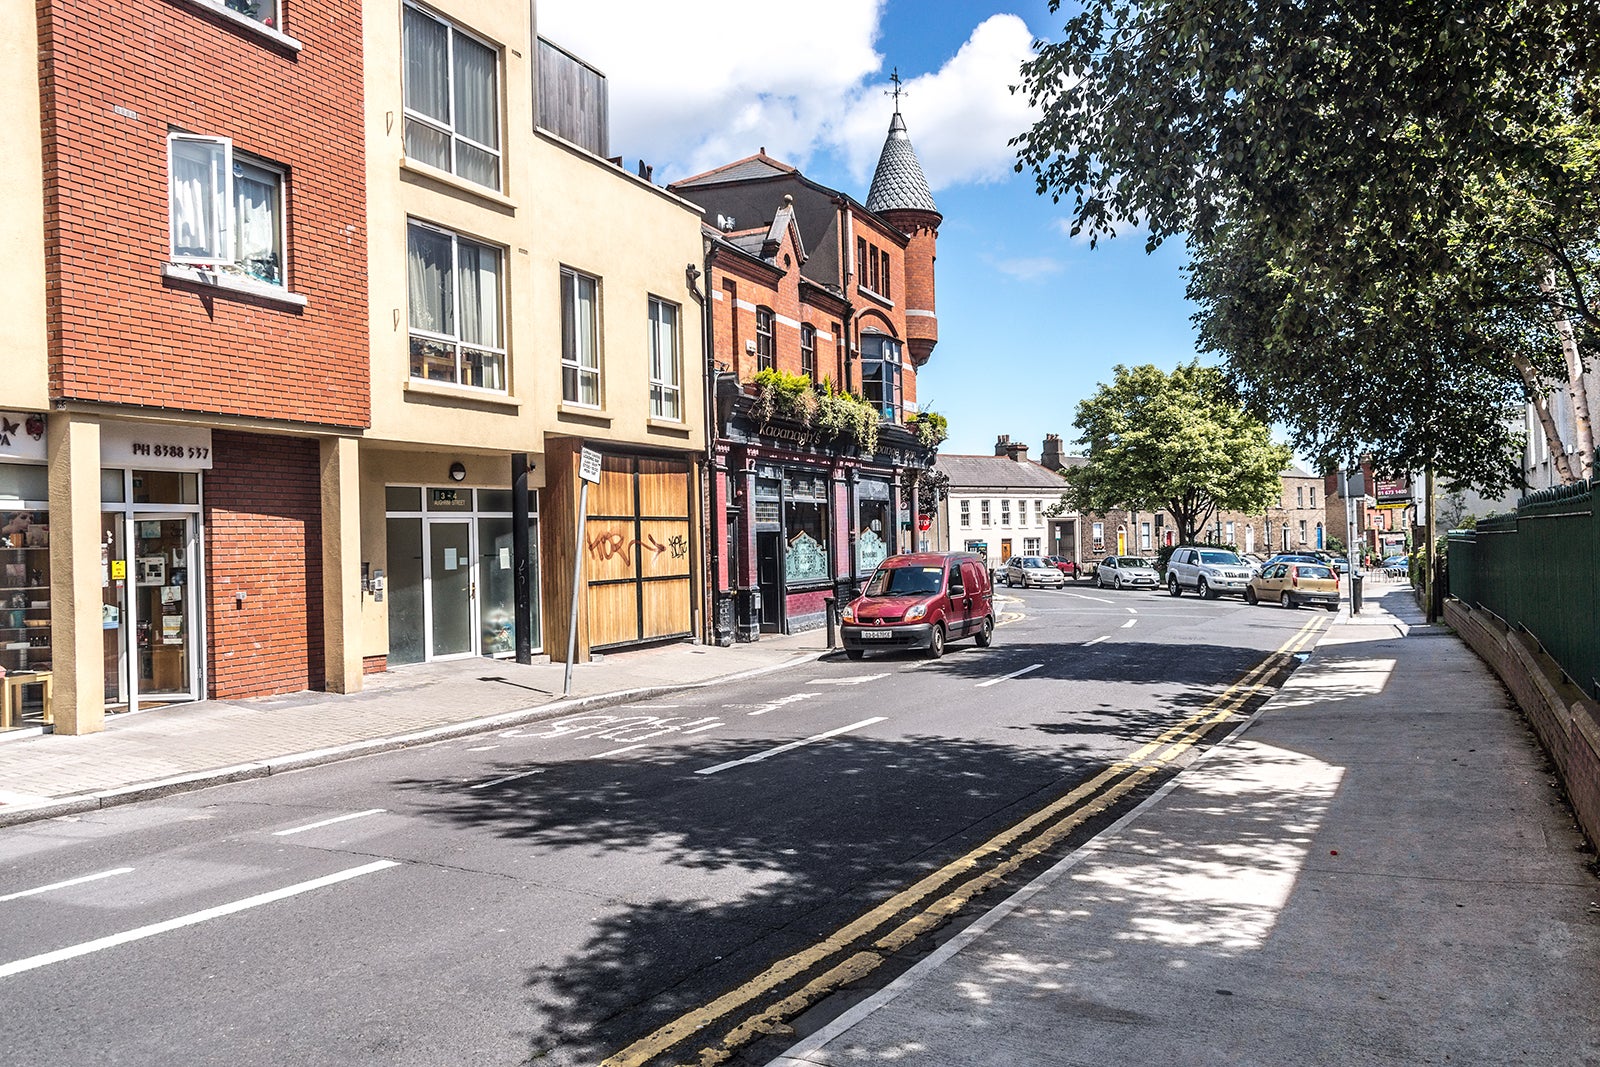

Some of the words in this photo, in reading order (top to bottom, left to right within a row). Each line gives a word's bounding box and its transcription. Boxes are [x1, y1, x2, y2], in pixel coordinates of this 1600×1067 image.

[758, 421, 821, 447] Kavanagh's
[133, 443, 150, 456] PH
[154, 444, 184, 458] 8388
[188, 447, 209, 460] 537
